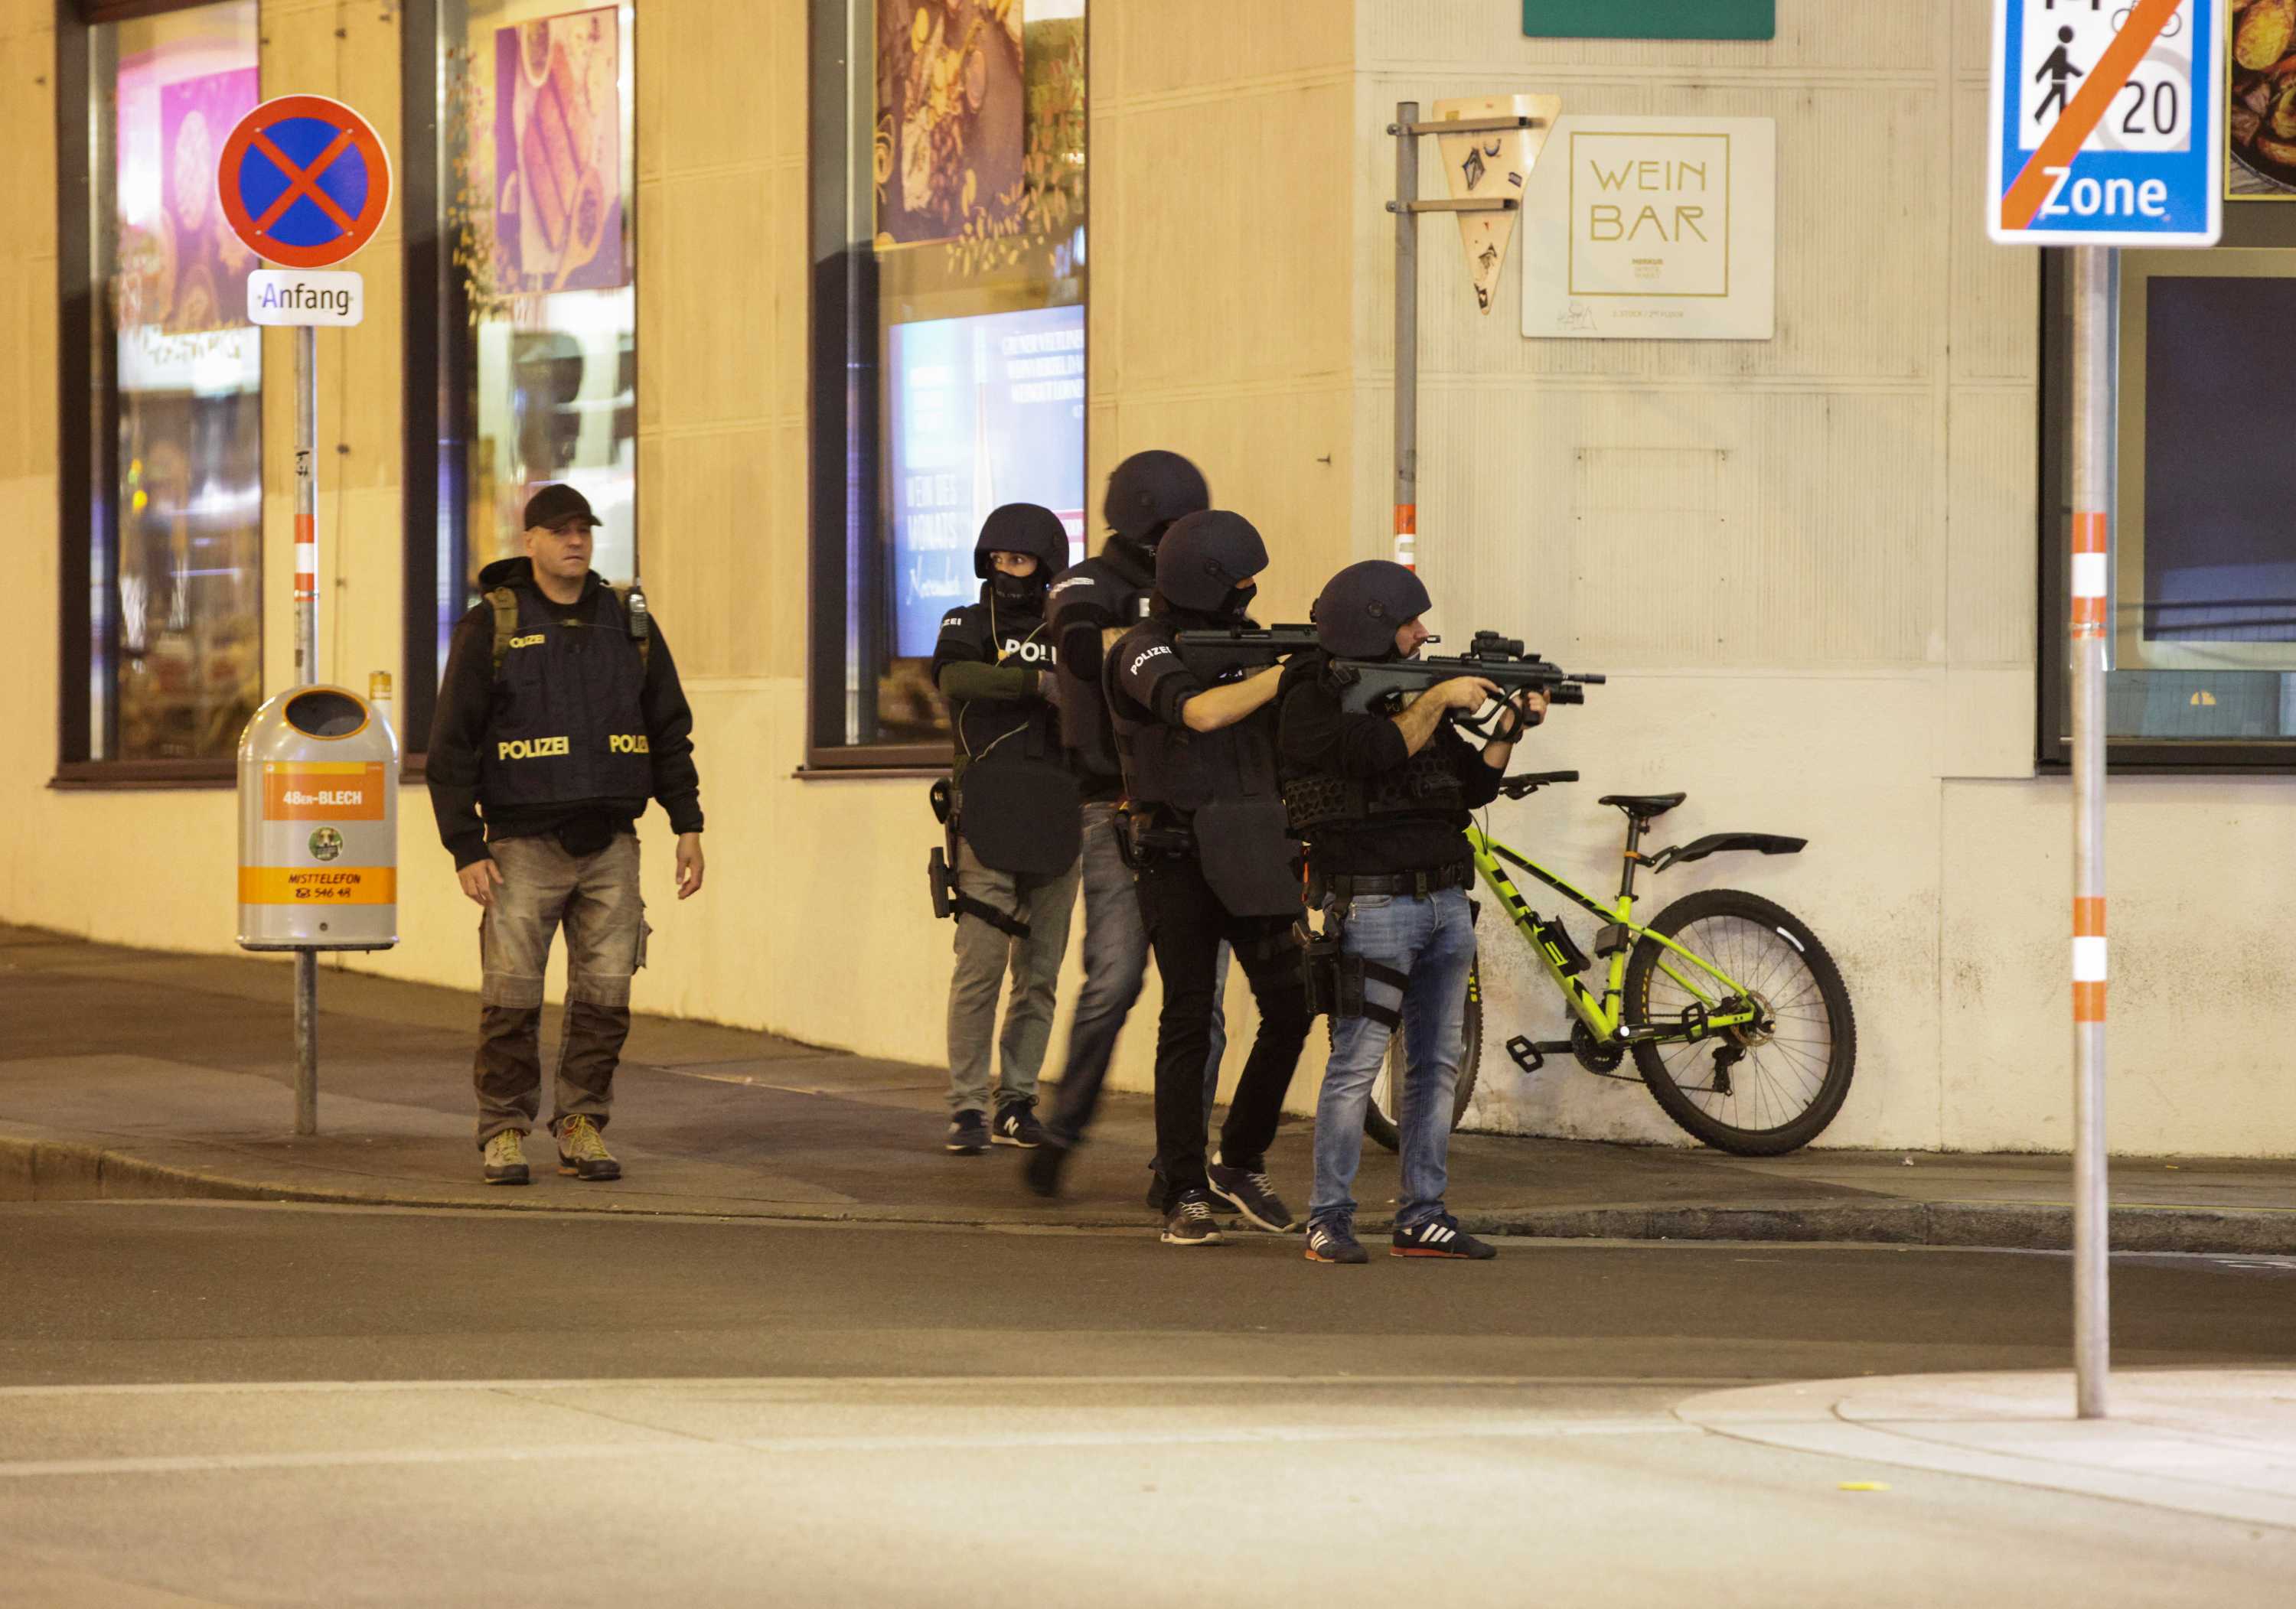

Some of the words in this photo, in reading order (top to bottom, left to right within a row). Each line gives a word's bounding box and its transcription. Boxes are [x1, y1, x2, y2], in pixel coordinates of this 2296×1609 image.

[2122, 80, 2178, 135] 20
[1590, 159, 1706, 191] WEIN
[2040, 165, 2168, 217] Zone
[1590, 204, 1708, 243] BAR
[261, 282, 350, 316] Anfang
[509, 634, 546, 648] OLIZEI
[1004, 638, 1058, 665] POLI
[1130, 646, 1172, 676] POLIZEI
[498, 736, 570, 761] POLIZEI
[289, 874, 361, 884] MISTTELEFON
